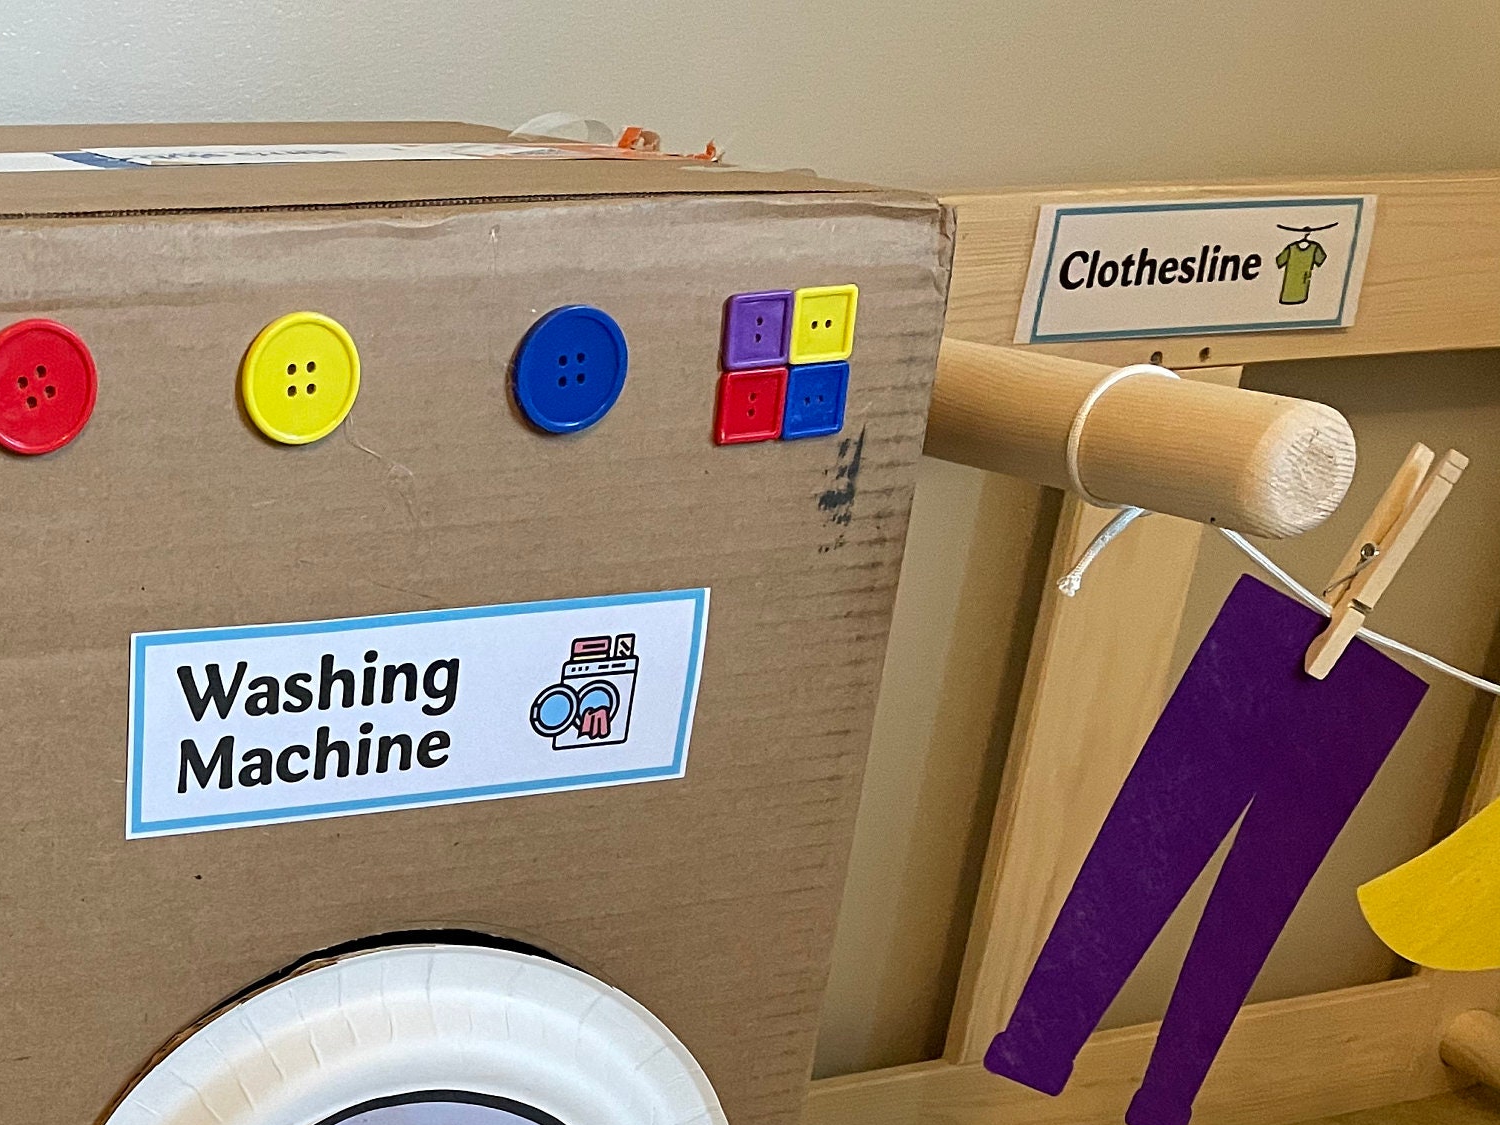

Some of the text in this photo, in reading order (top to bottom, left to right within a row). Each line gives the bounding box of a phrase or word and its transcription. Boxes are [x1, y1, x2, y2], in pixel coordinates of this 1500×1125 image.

[1059, 244, 1261, 290] Clothesline
[176, 650, 460, 722] Washing
[177, 722, 450, 794] Machine
